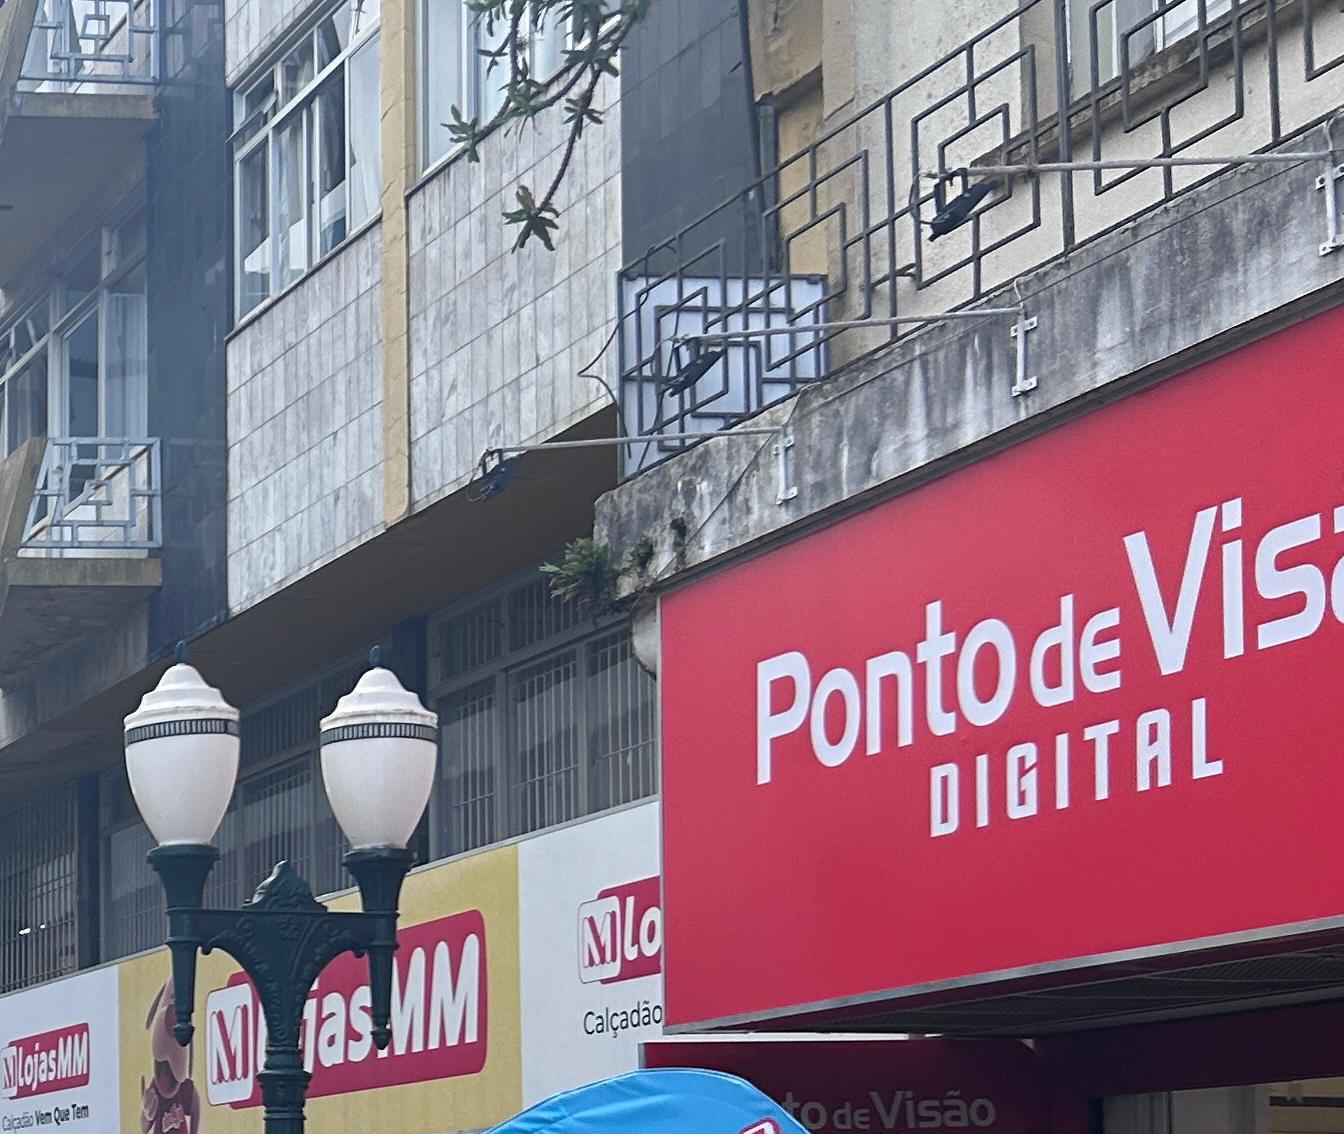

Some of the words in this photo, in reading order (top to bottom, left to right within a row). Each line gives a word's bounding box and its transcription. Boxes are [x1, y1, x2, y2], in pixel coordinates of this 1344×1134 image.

[756, 600, 1017, 786] Ponto
[1030, 593, 1121, 708] de
[929, 697, 1225, 838] DIGITAL
[583, 1000, 662, 1039] Calçadão
[34, 1109, 53, 1126] Vem
[54, 1106, 70, 1126] Que
[72, 1103, 90, 1120] Tem
[833, 1103, 870, 1130] de
[869, 1088, 997, 1130] Visão
